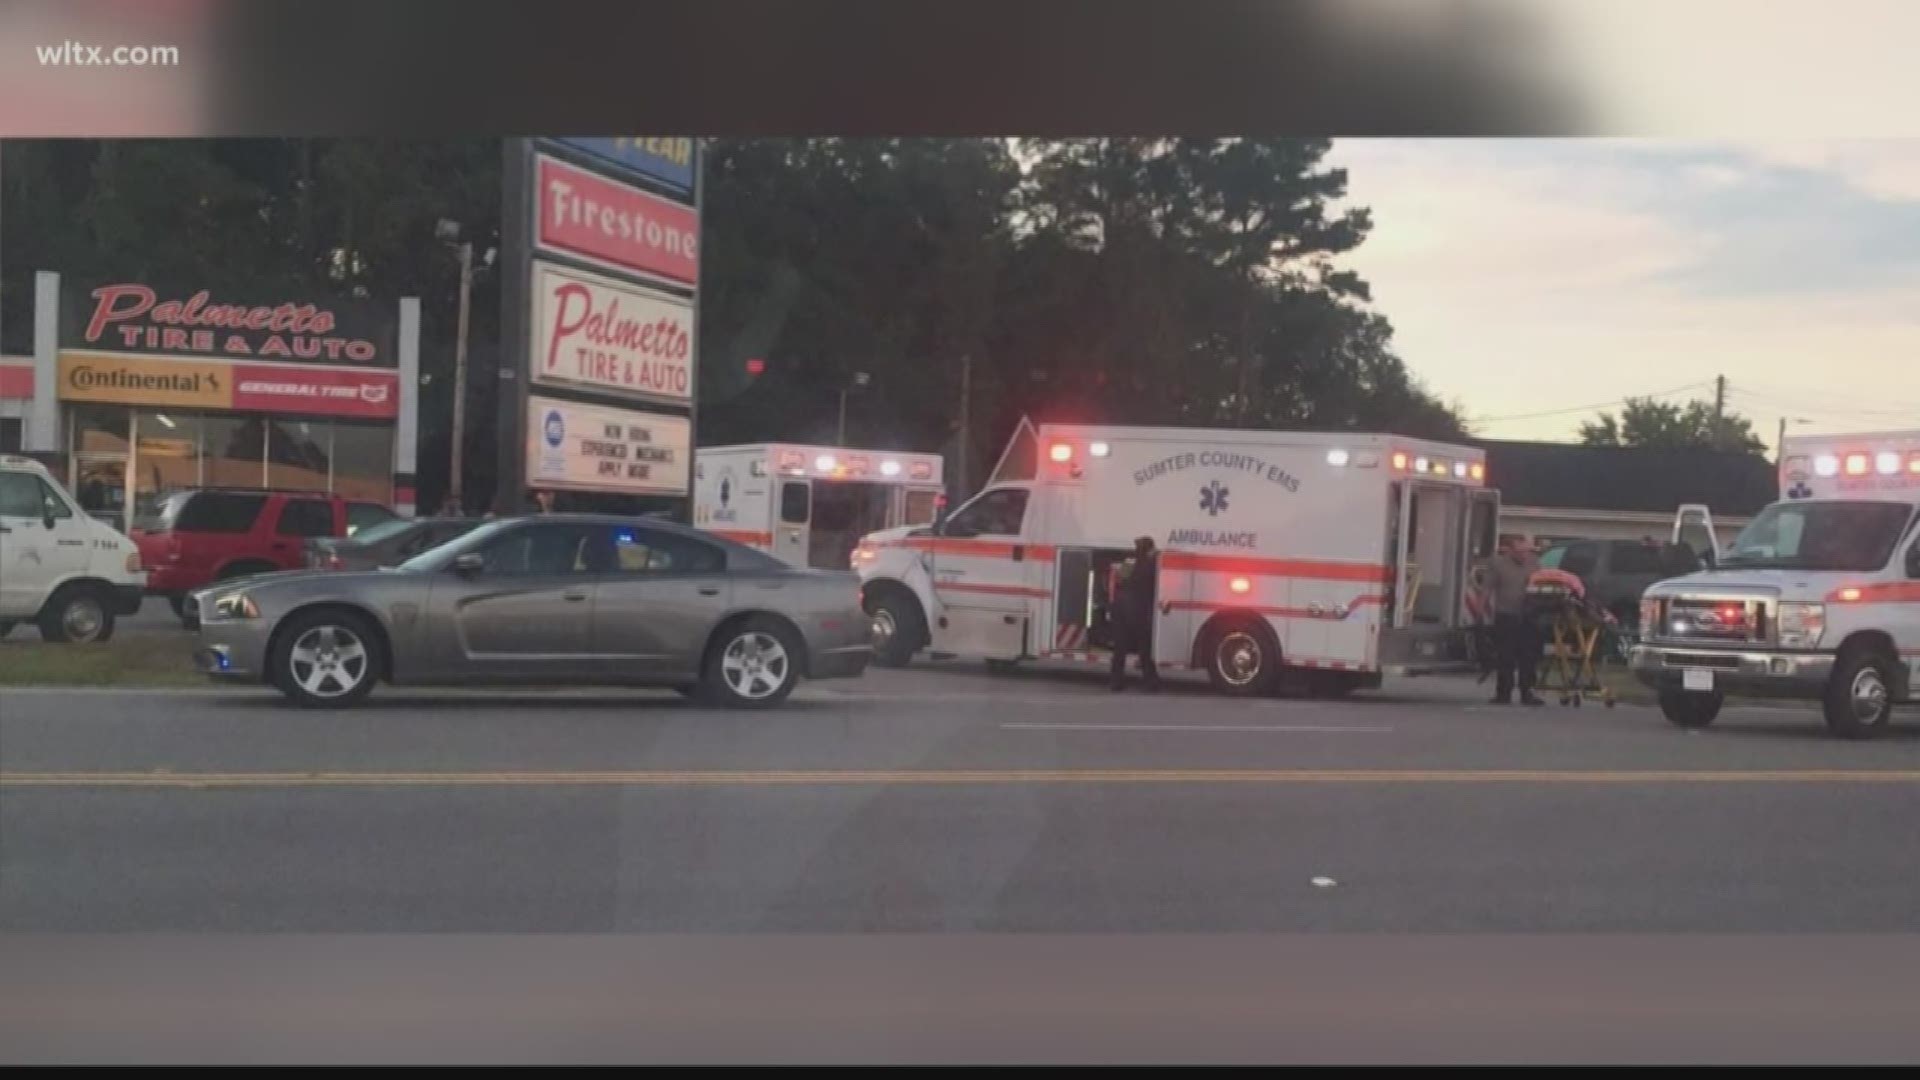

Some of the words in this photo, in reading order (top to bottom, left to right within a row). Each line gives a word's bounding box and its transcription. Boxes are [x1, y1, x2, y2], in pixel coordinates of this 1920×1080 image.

[550, 179, 697, 260] Firestone
[84, 284, 336, 342] Palmetto
[547, 282, 689, 370] Palmetto
[117, 325, 215, 351] TIRE
[223, 335, 251, 354] &
[258, 335, 376, 361] AUTO
[69, 365, 201, 392] Continental
[239, 382, 318, 396] GENERAL
[576, 347, 619, 382] TIRE
[623, 360, 634, 385] &
[639, 359, 689, 393] AUTO
[1133, 452, 1196, 486] SUMTER
[1199, 450, 1266, 475] COUNTY
[1267, 463, 1301, 493] EMS
[1167, 528, 1258, 548] AMBULANCE
